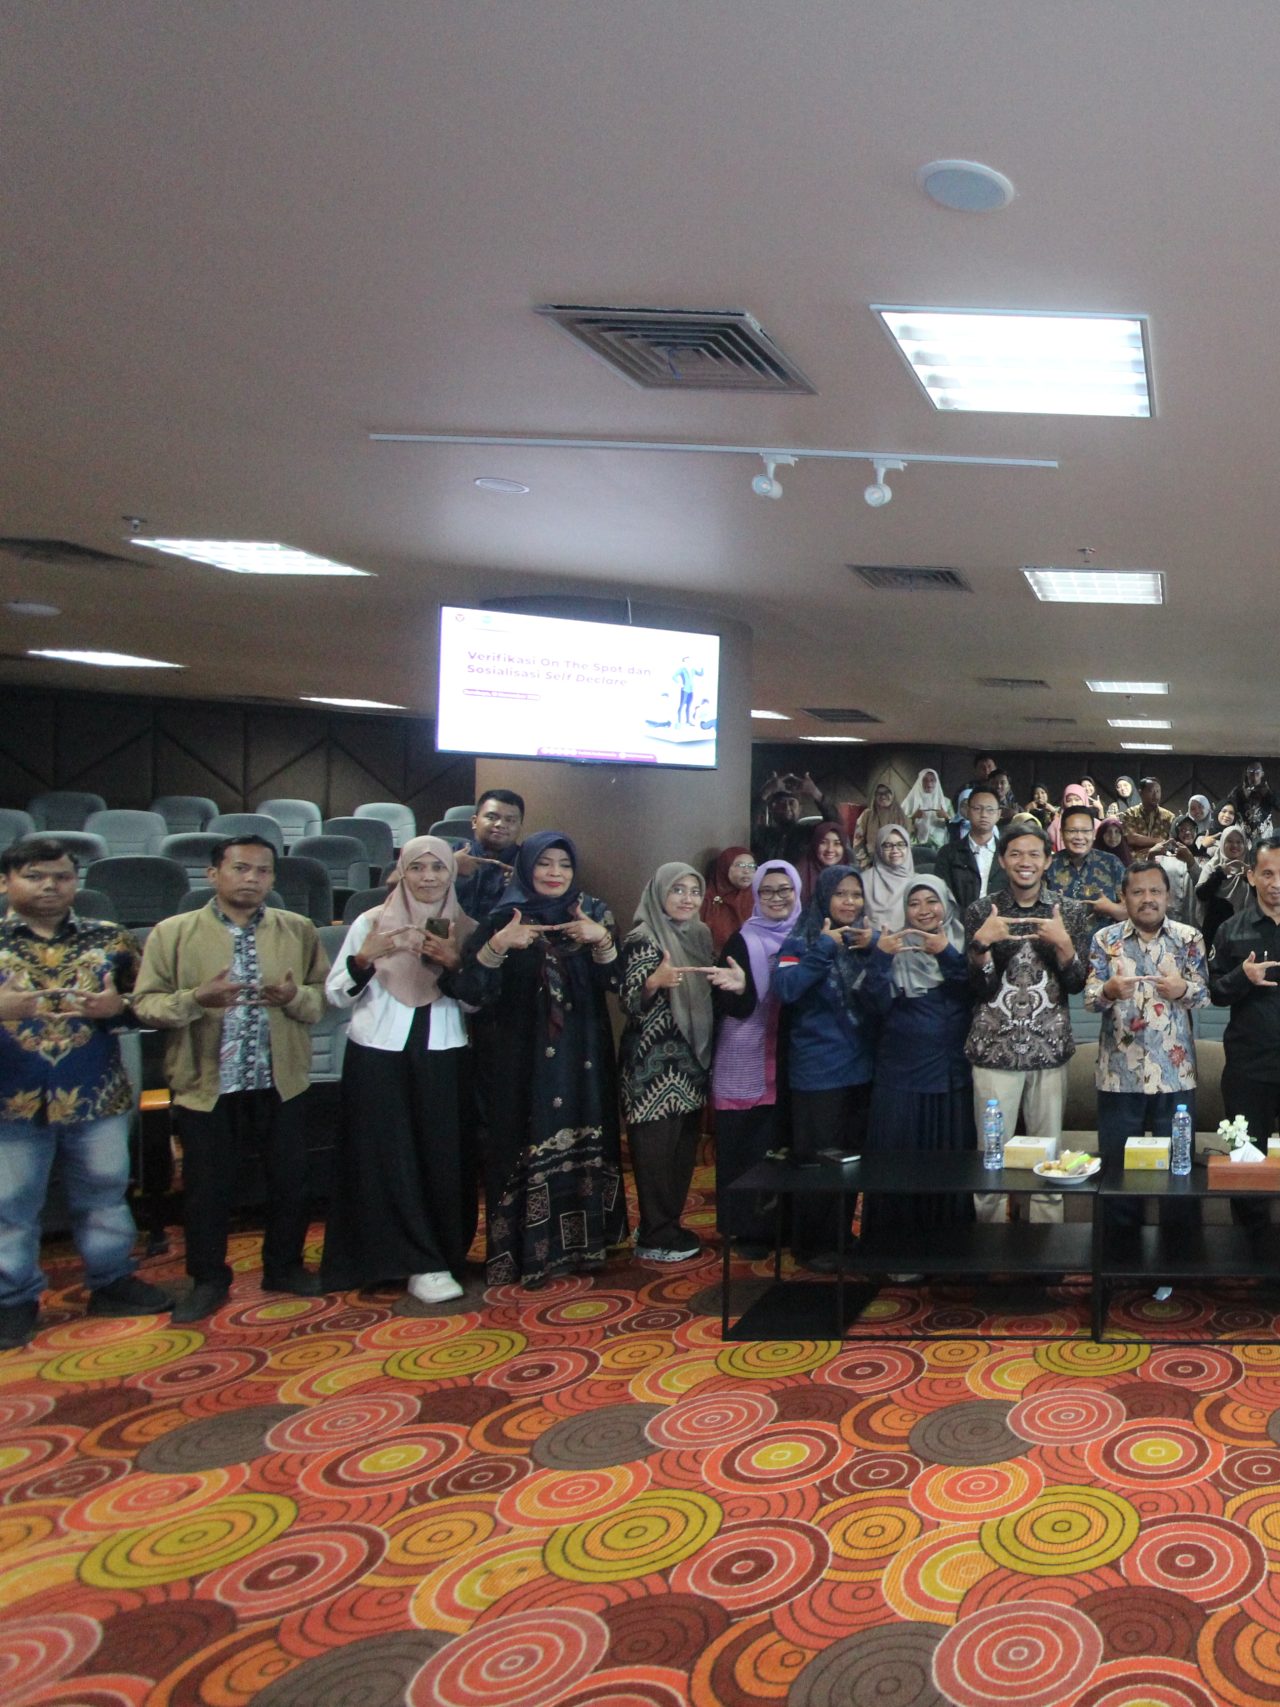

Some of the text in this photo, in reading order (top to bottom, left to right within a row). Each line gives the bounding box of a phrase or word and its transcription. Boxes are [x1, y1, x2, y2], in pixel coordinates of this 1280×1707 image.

[467, 650, 652, 676] Verifikasi On The Spot dan
[545, 670, 572, 681] Self
